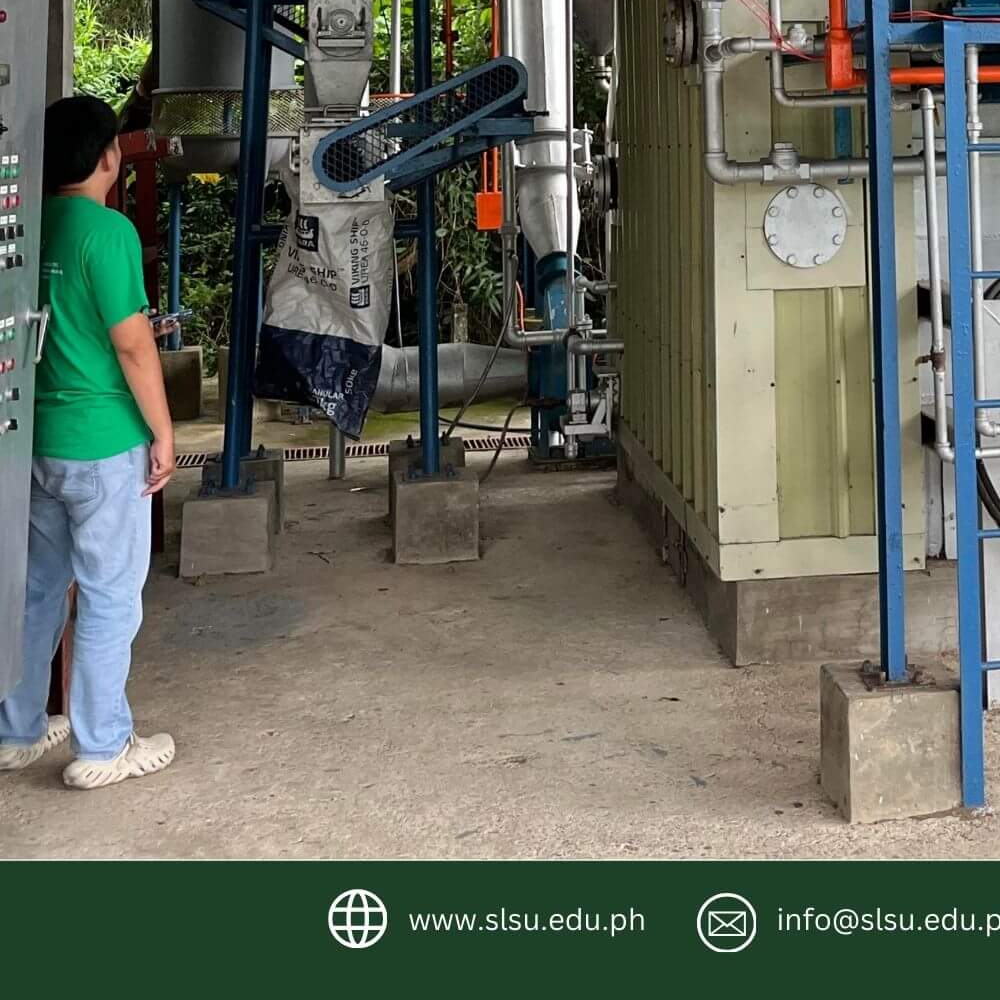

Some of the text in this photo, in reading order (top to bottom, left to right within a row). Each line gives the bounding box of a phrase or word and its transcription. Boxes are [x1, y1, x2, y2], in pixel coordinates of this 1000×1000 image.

[350, 216, 360, 286] VIKING SHIP
[361, 254, 369, 284] UREA
